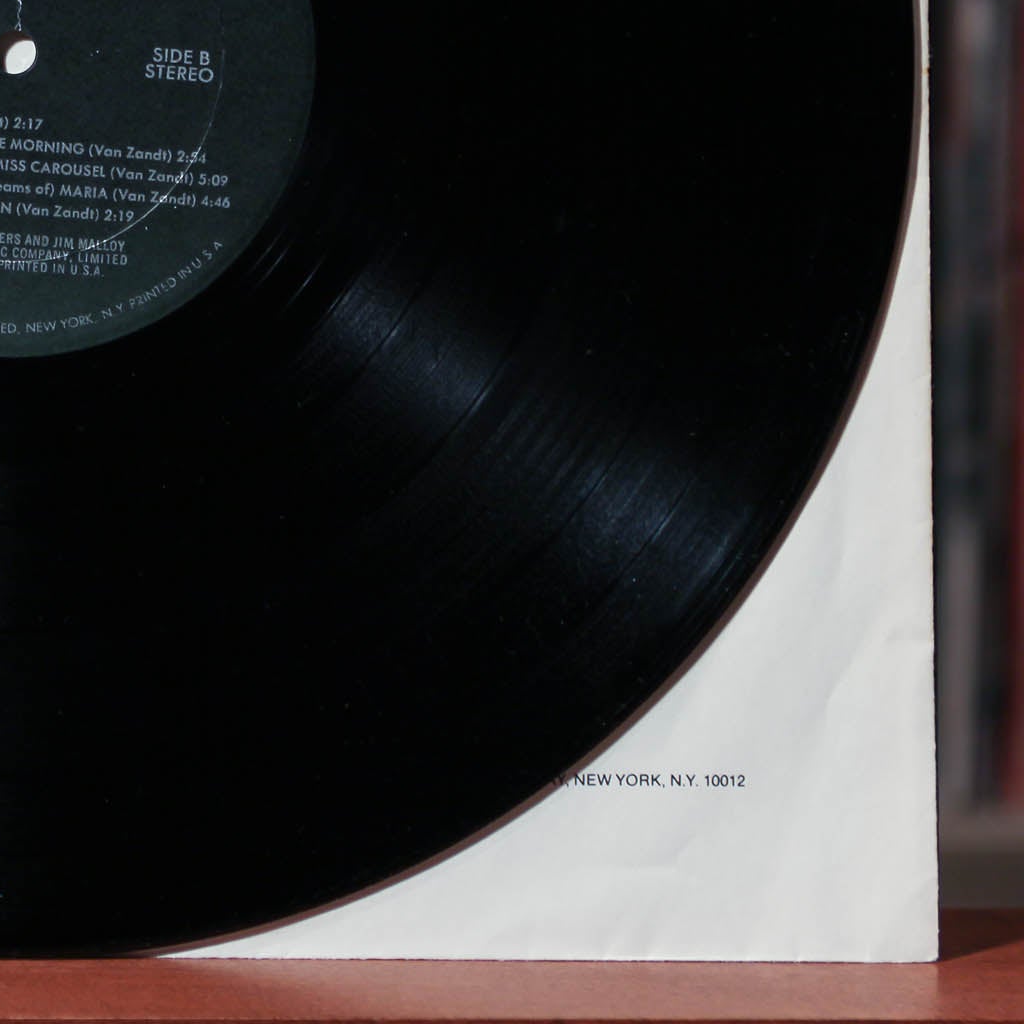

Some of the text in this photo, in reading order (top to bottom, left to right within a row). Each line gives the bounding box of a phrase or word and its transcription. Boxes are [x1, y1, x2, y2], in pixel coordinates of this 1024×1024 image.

[153, 47, 211, 66] SIDE B
[144, 63, 214, 83] STEREO
[13, 117, 44, 131] 2:17
[9, 138, 85, 156] MORNING
[88, 143, 122, 160] (Van
[126, 146, 173, 164] Zandt)
[29, 160, 106, 179] CAROUSEL
[110, 166, 144, 183] (Van
[147, 169, 194, 187] Zandt)
[197, 173, 229, 188] 5:09
[34, 182, 55, 198] of)
[59, 184, 109, 200] MARIA
[112, 188, 146, 204] (Van
[200, 195, 232, 210] 4:46
[15, 202, 49, 218] (Van
[52, 205, 100, 222] Zandt)
[103, 210, 135, 224] 2:19
[24, 233, 50, 247] AND
[53, 236, 75, 250] JIM
[78, 237, 126, 253] MALLOY
[52, 262, 66, 275] IN
[78, 251, 128, 266] LIMITED
[25, 321, 57, 333] NEW
[176, 265, 193, 280] IN
[575, 773, 613, 786] NEW
[616, 774, 666, 788] YORK,
[670, 775, 699, 787] N.Y.
[705, 775, 746, 787] 10012
